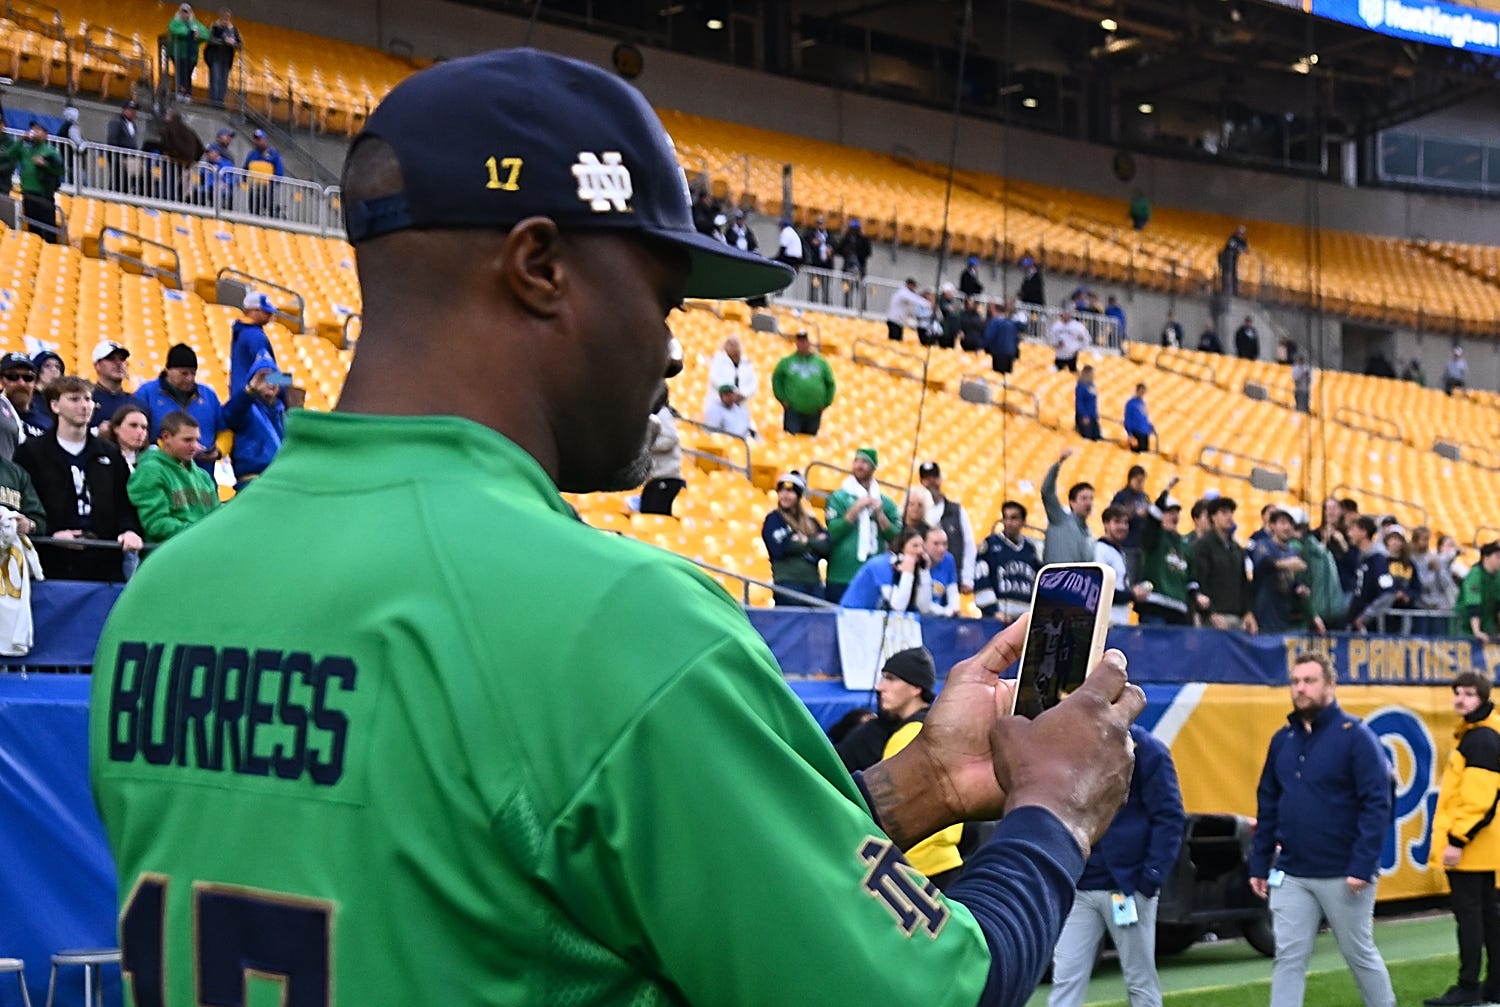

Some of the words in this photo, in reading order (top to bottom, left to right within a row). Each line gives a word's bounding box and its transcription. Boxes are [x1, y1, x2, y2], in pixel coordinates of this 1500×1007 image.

[1385, 0, 1498, 48] Huntington
[485, 156, 524, 191] 17
[998, 578, 1032, 595] DAM
[1351, 639, 1473, 681] PANTHER
[109, 641, 358, 786] BURRESS
